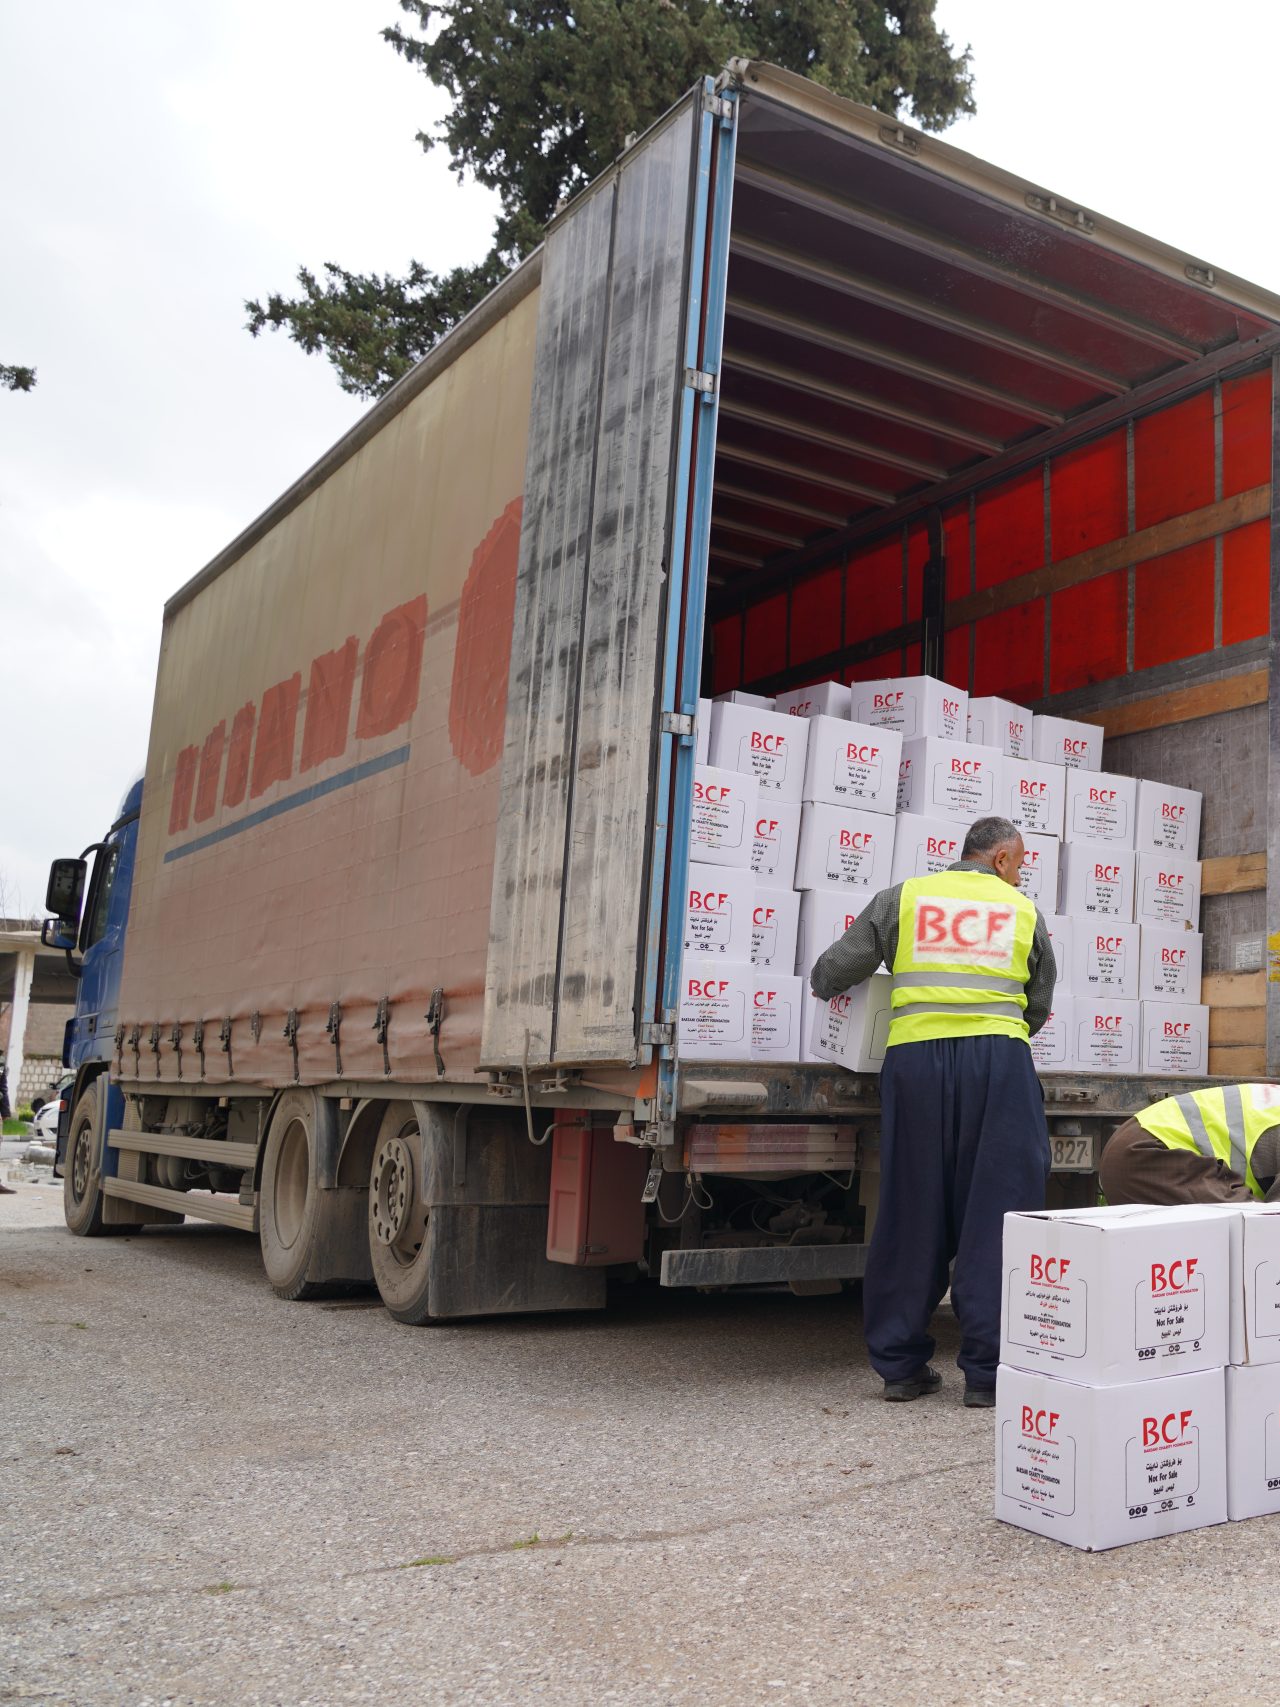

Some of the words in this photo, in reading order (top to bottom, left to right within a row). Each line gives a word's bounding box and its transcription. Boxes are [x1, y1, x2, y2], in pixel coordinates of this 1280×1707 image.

[874, 692, 904, 708] BCF
[943, 699, 959, 716] BCF
[1009, 721, 1023, 738] BCF
[751, 732, 784, 752] BCF
[1064, 738, 1088, 754] BCF
[847, 743, 879, 762] BCF
[951, 759, 982, 775] BCF
[694, 782, 731, 802] BCF
[1020, 780, 1047, 797] BCF
[1090, 788, 1117, 803] BCF
[1162, 803, 1185, 819] BCF
[756, 820, 779, 836] CF
[840, 830, 872, 849] BCF
[927, 838, 957, 855] BCF
[1095, 864, 1120, 881] BCF
[1159, 872, 1184, 888] BCF
[690, 891, 729, 911] BCF
[753, 908, 775, 925] CF
[917, 905, 1010, 946] BCF
[1096, 936, 1122, 952] BCF
[1162, 948, 1186, 964] BCF
[689, 980, 730, 998] BCF
[754, 991, 777, 1007] CF
[831, 994, 852, 1013] BCF
[1095, 1016, 1122, 1030] BCF
[1164, 1022, 1191, 1036] BCF
[1054, 1140, 1087, 1164] 827
[1031, 1254, 1070, 1283] BCF
[1151, 1258, 1198, 1291] BCF
[1157, 1319, 1165, 1327] Not
[1176, 1316, 1184, 1324] Sale
[1022, 1405, 1060, 1437] BCF
[1143, 1410, 1193, 1447] BCF
[1148, 1475, 1157, 1483] Not
[1159, 1473, 1167, 1481] For
[1169, 1470, 1177, 1479] Sale
